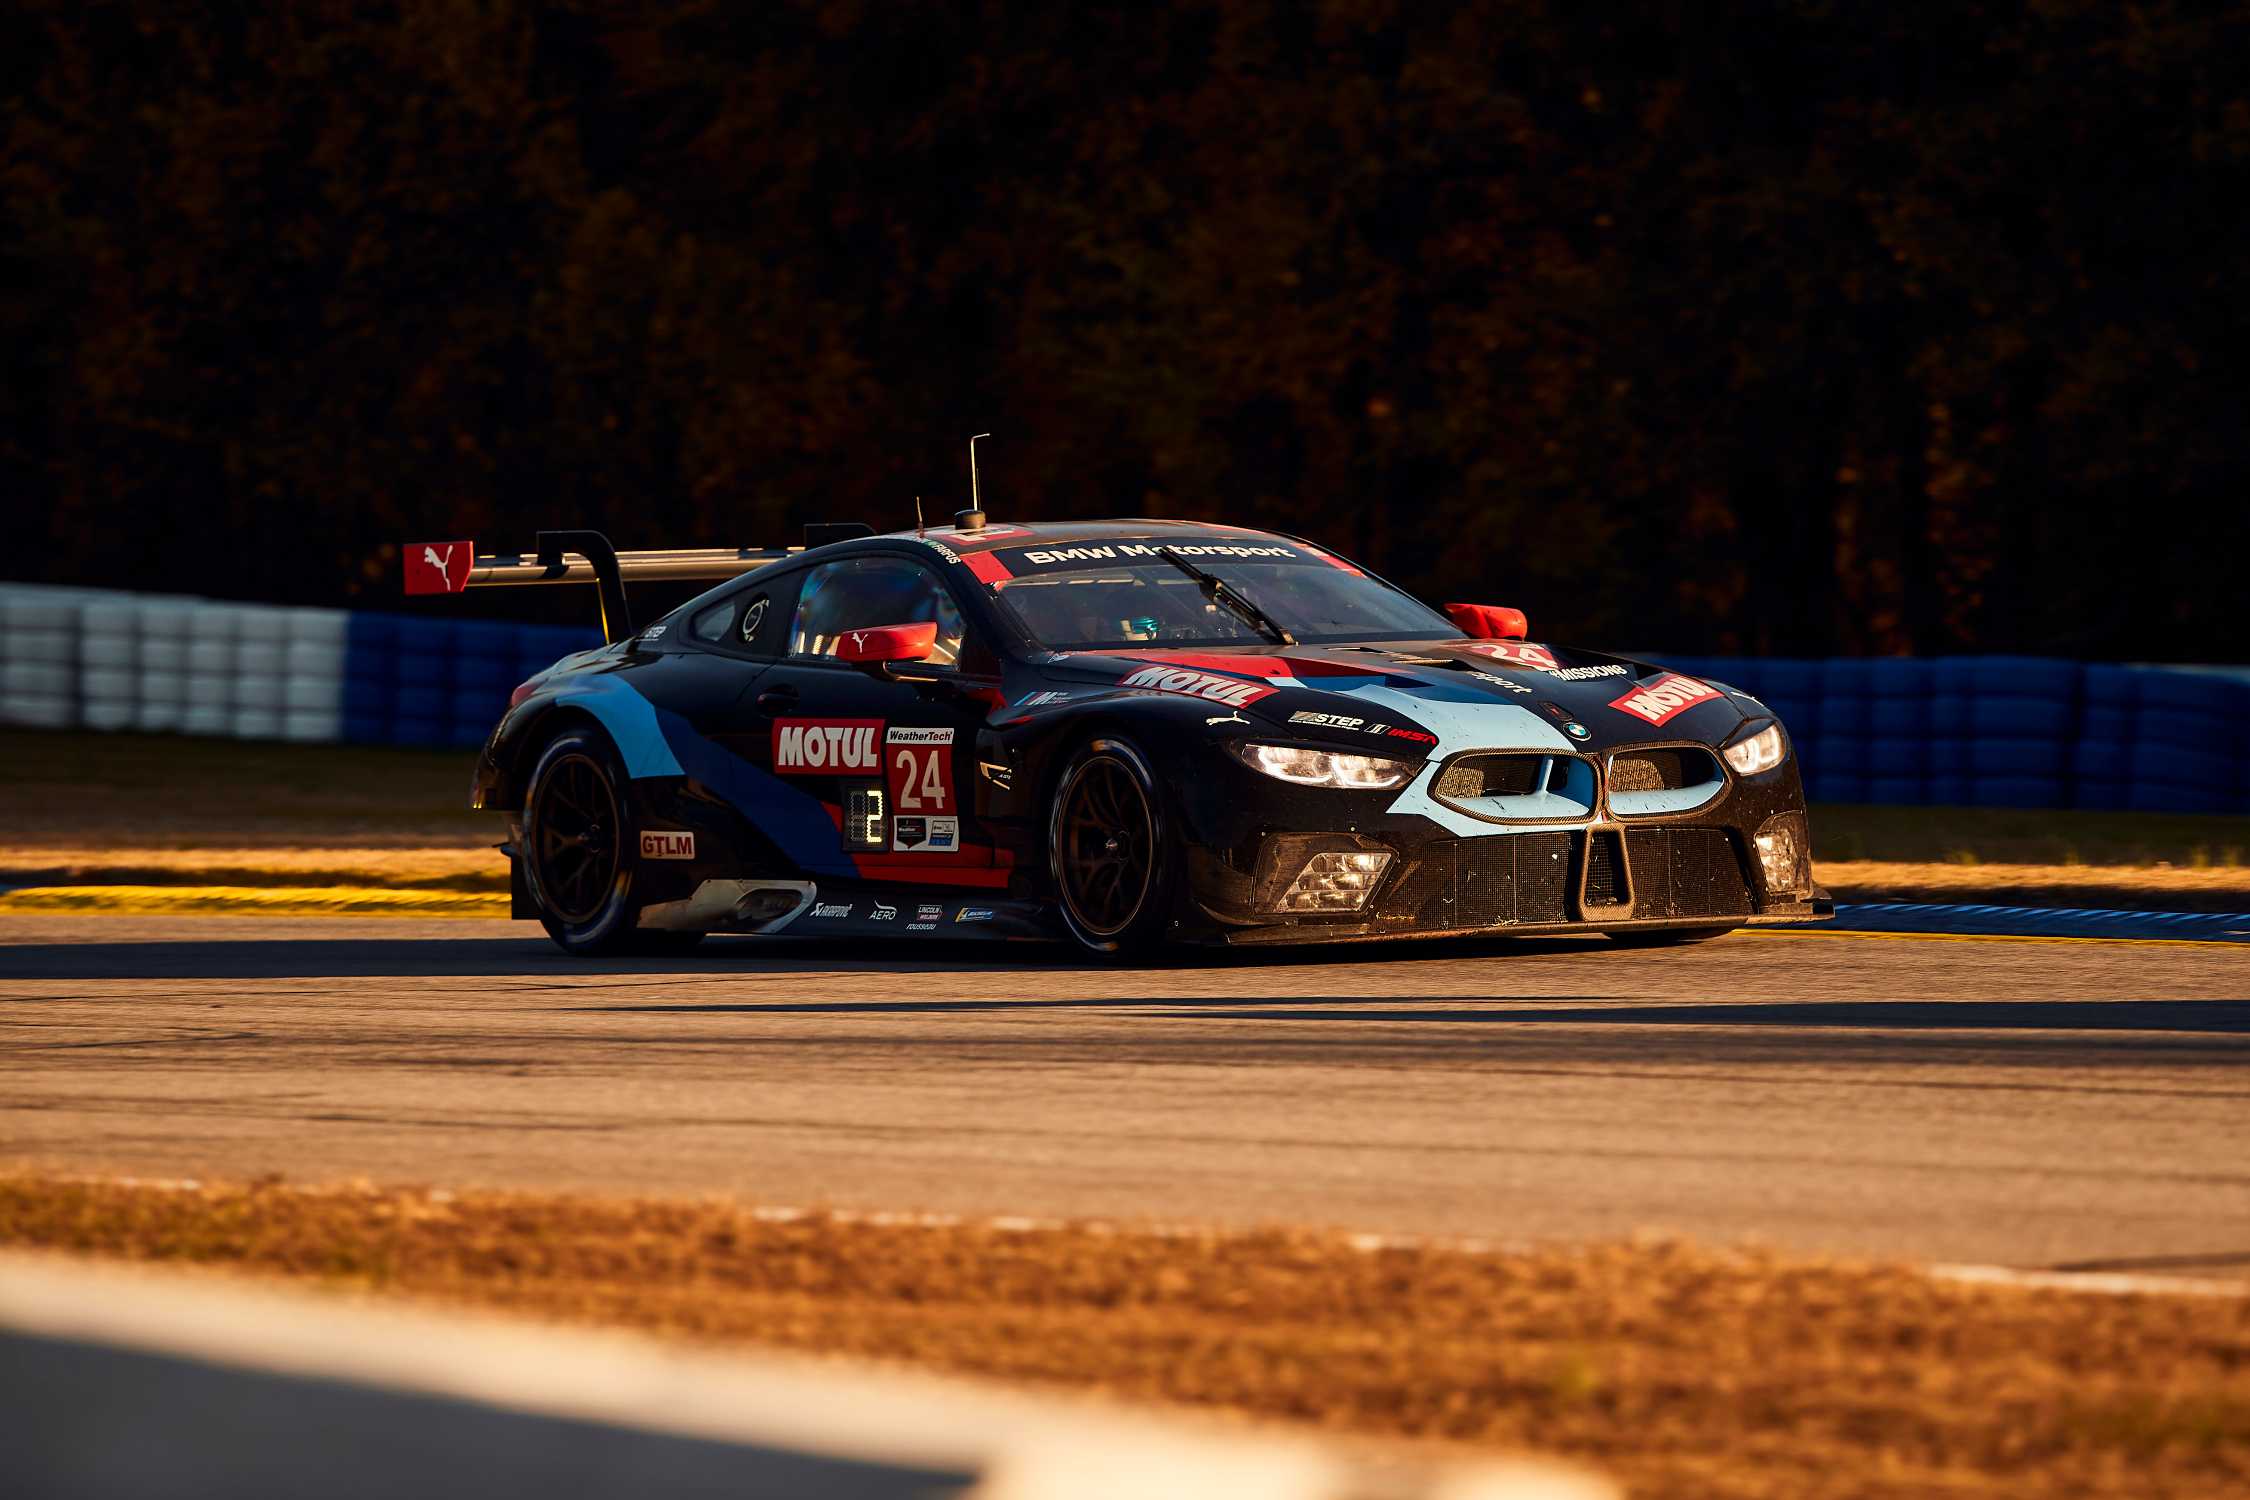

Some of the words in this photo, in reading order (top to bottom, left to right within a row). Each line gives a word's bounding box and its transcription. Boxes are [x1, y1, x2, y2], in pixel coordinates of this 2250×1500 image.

[1024, 546, 1117, 564] BMW
[1472, 645, 1559, 669] 24
[1123, 666, 1265, 706] MOTUL
[1314, 713, 1364, 727] STEP
[890, 730, 952, 741] WeatherTech
[778, 726, 878, 768] MOTUL
[896, 750, 946, 809] 24
[866, 790, 883, 843] 2
[642, 835, 692, 855] GTLM
[868, 910, 896, 920] AERO
